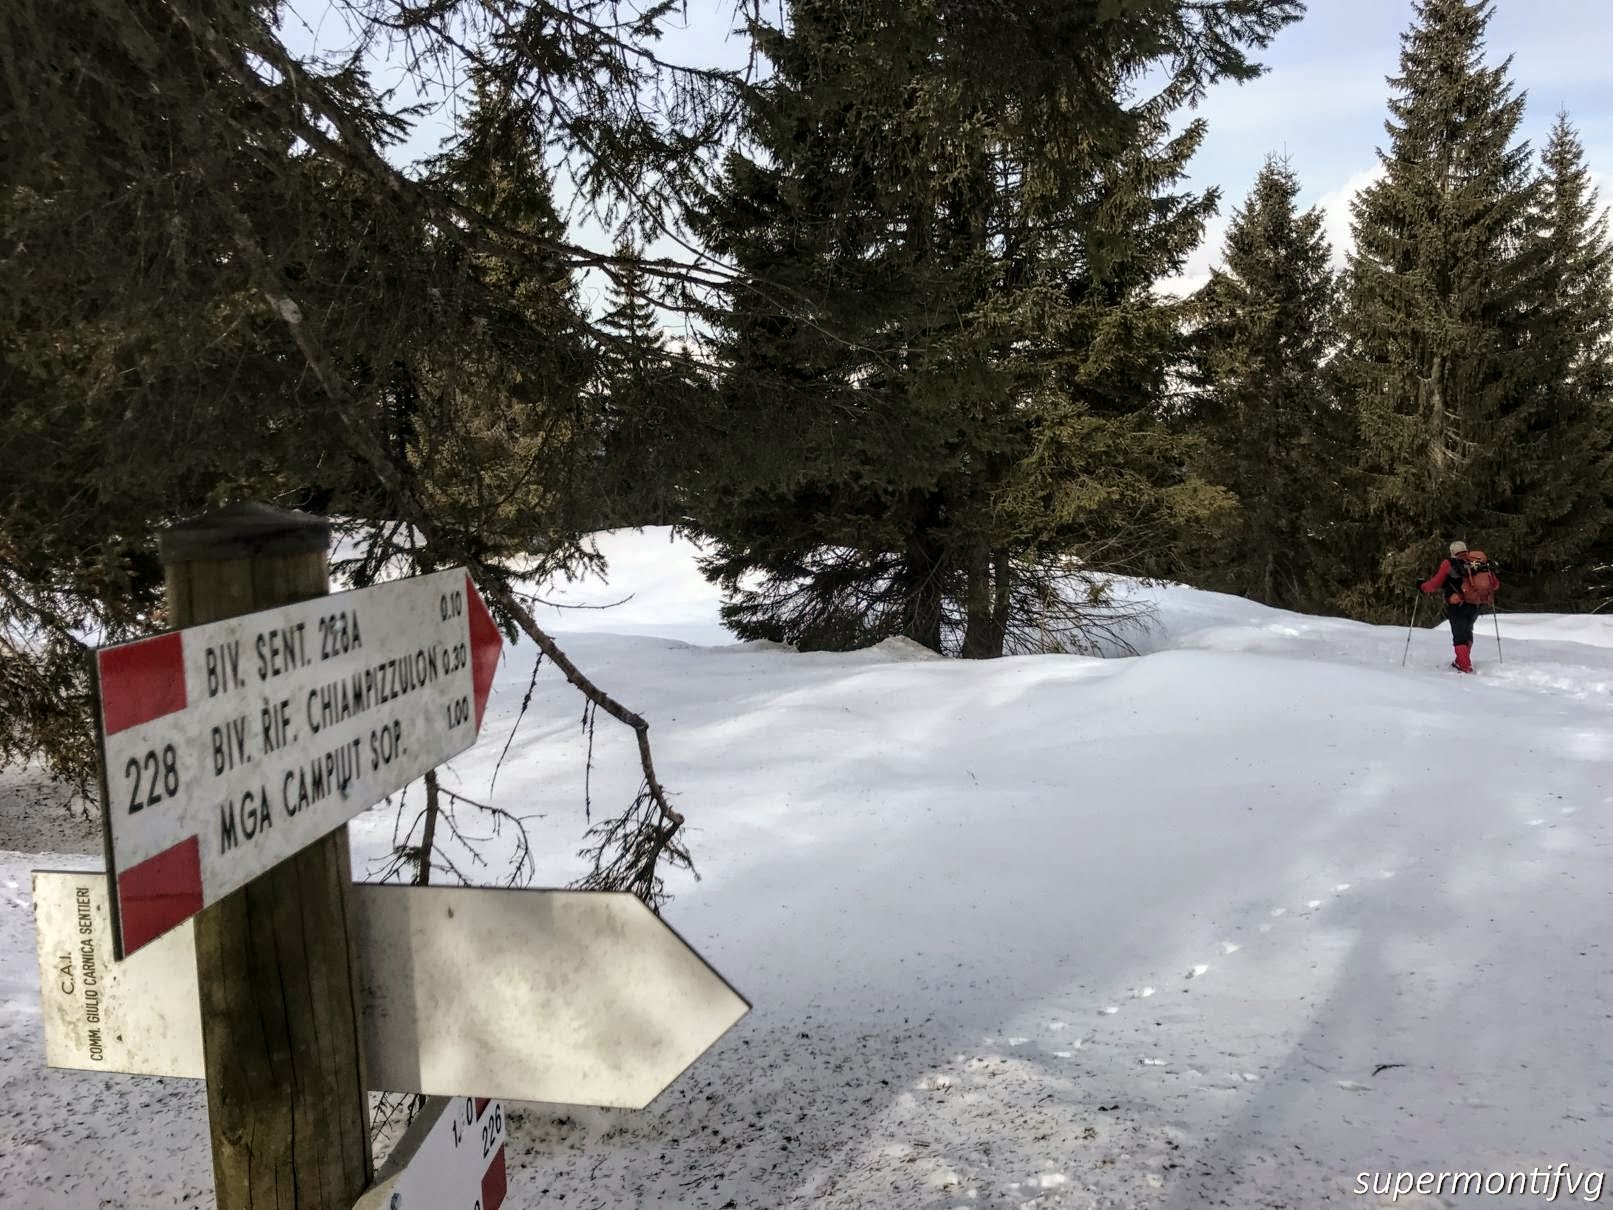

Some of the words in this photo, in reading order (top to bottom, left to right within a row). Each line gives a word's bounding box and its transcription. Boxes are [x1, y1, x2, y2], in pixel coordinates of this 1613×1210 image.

[205, 640, 245, 698] BIV.
[256, 622, 312, 681] SENT.
[319, 609, 362, 661] 228A
[440, 591, 462, 622] 0.10
[211, 716, 252, 776] BIV.
[261, 699, 299, 755] RIF.
[307, 645, 438, 734] CHIAMPIZZULON
[442, 642, 467, 675] 0.30
[125, 743, 179, 815] 228
[220, 784, 273, 855] MGA
[370, 718, 408, 771] SOP.
[446, 696, 469, 730] 1.00
[76, 887, 92, 935] SENTIERI
[59, 951, 75, 995] C.A.I.
[80, 938, 96, 986] CARNICA
[85, 990, 99, 1023] GIULIO
[88, 1027, 103, 1061] COMM.
[482, 1104, 502, 1159] 226
